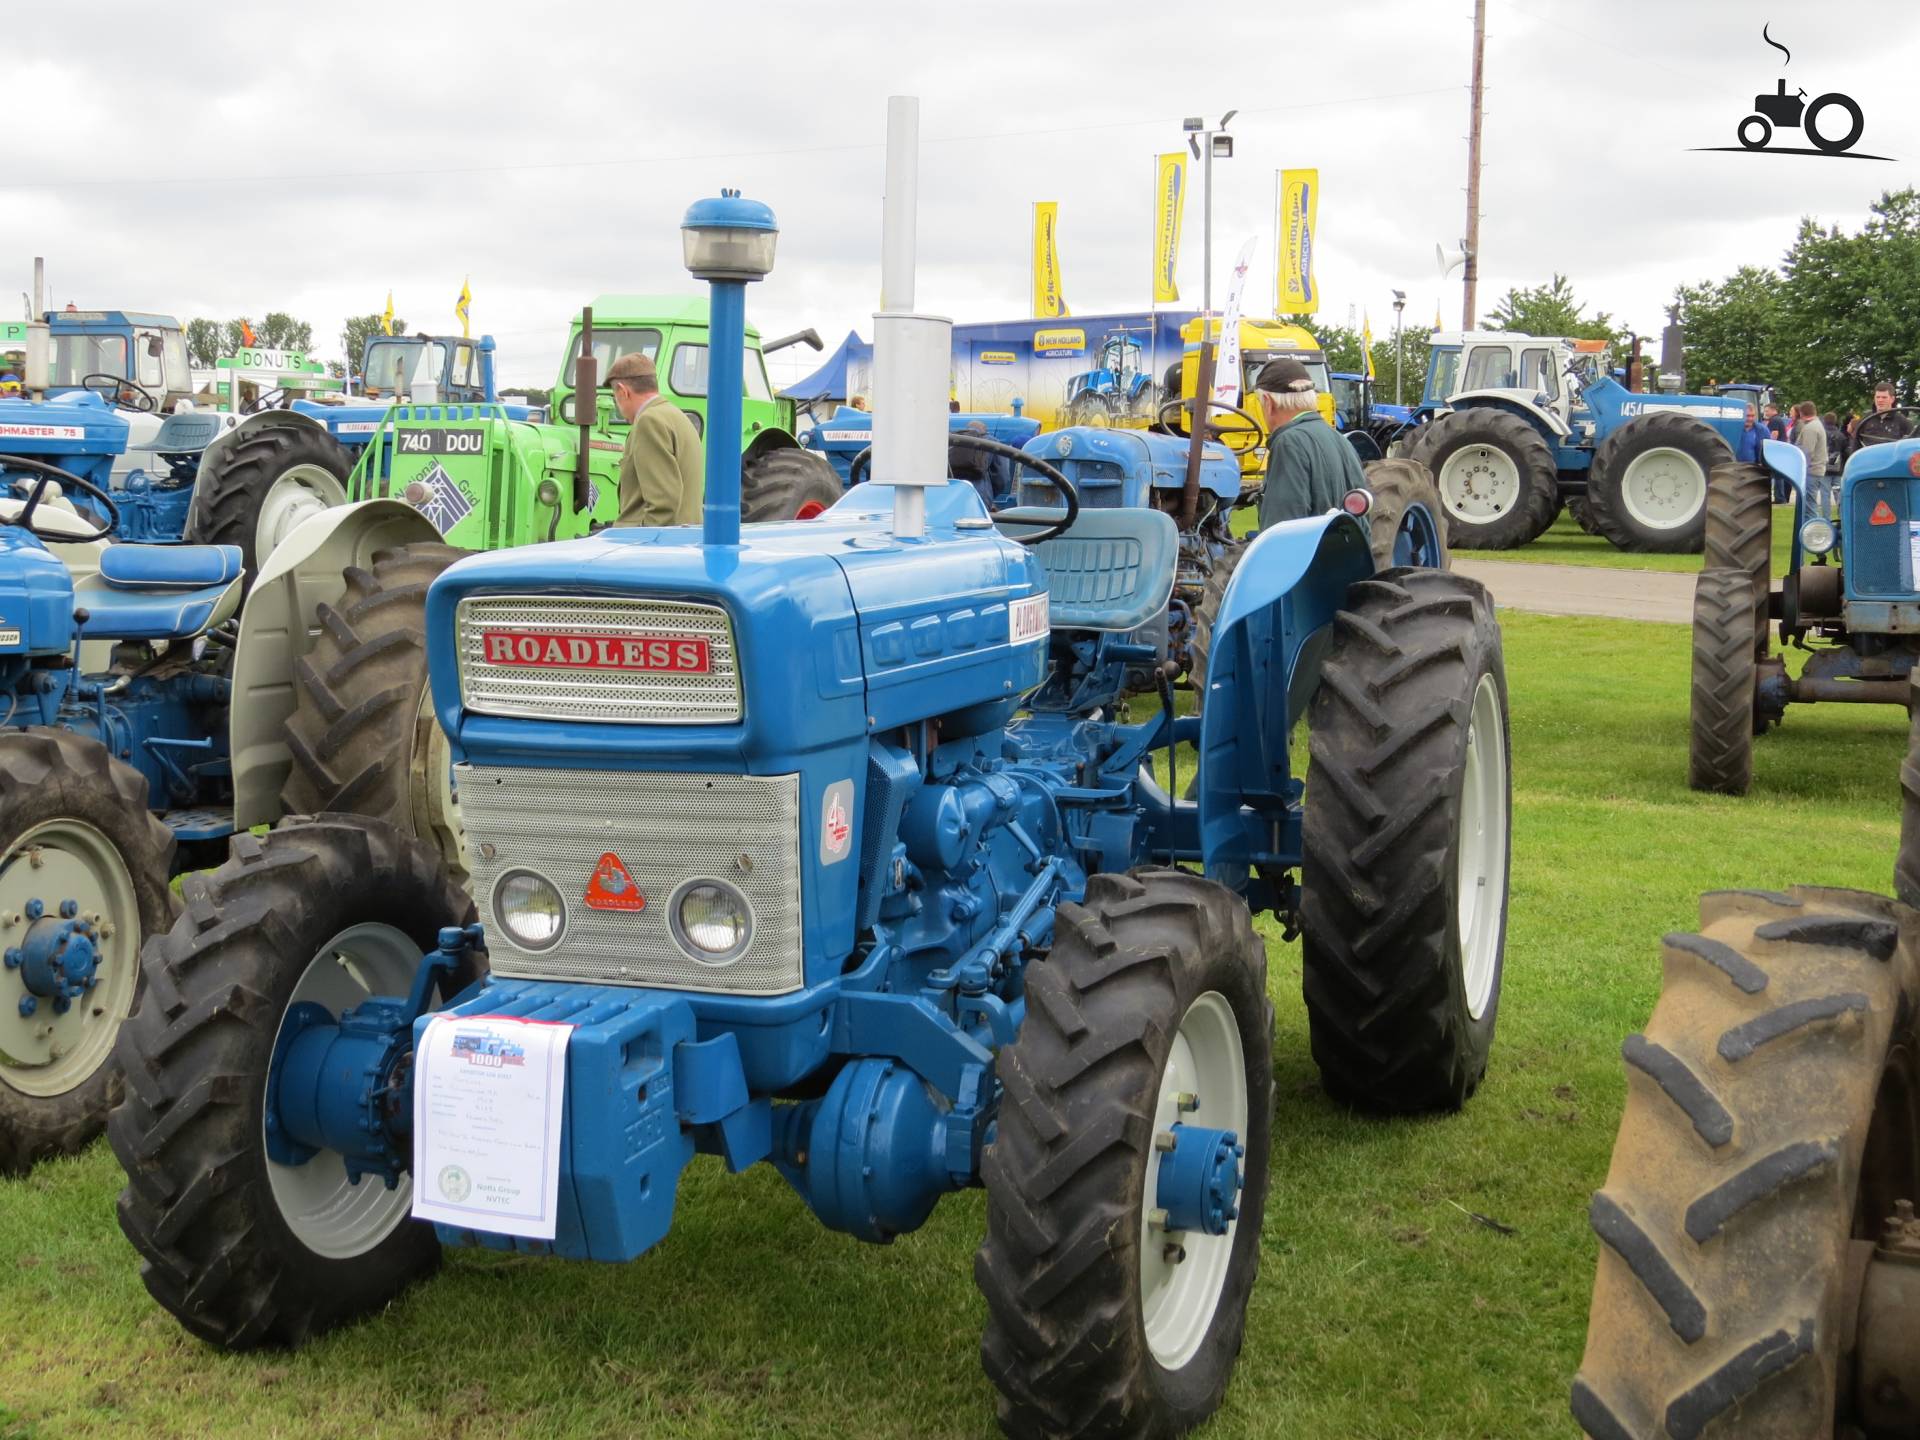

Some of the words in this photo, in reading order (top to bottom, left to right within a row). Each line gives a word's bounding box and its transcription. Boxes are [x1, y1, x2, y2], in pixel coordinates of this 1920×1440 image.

[1045, 336, 1057, 345] NEW
[1058, 336, 1081, 344] HOLLAND
[243, 352, 302, 369] DONUTS
[63, 428, 77, 437] 75
[401, 434, 431, 451] 740
[446, 434, 482, 451] DOU
[458, 479, 481, 507] Grid
[488, 635, 700, 669] ROADLESS
[470, 1053, 502, 1067] 1000
[498, 1186, 521, 1196] Group
